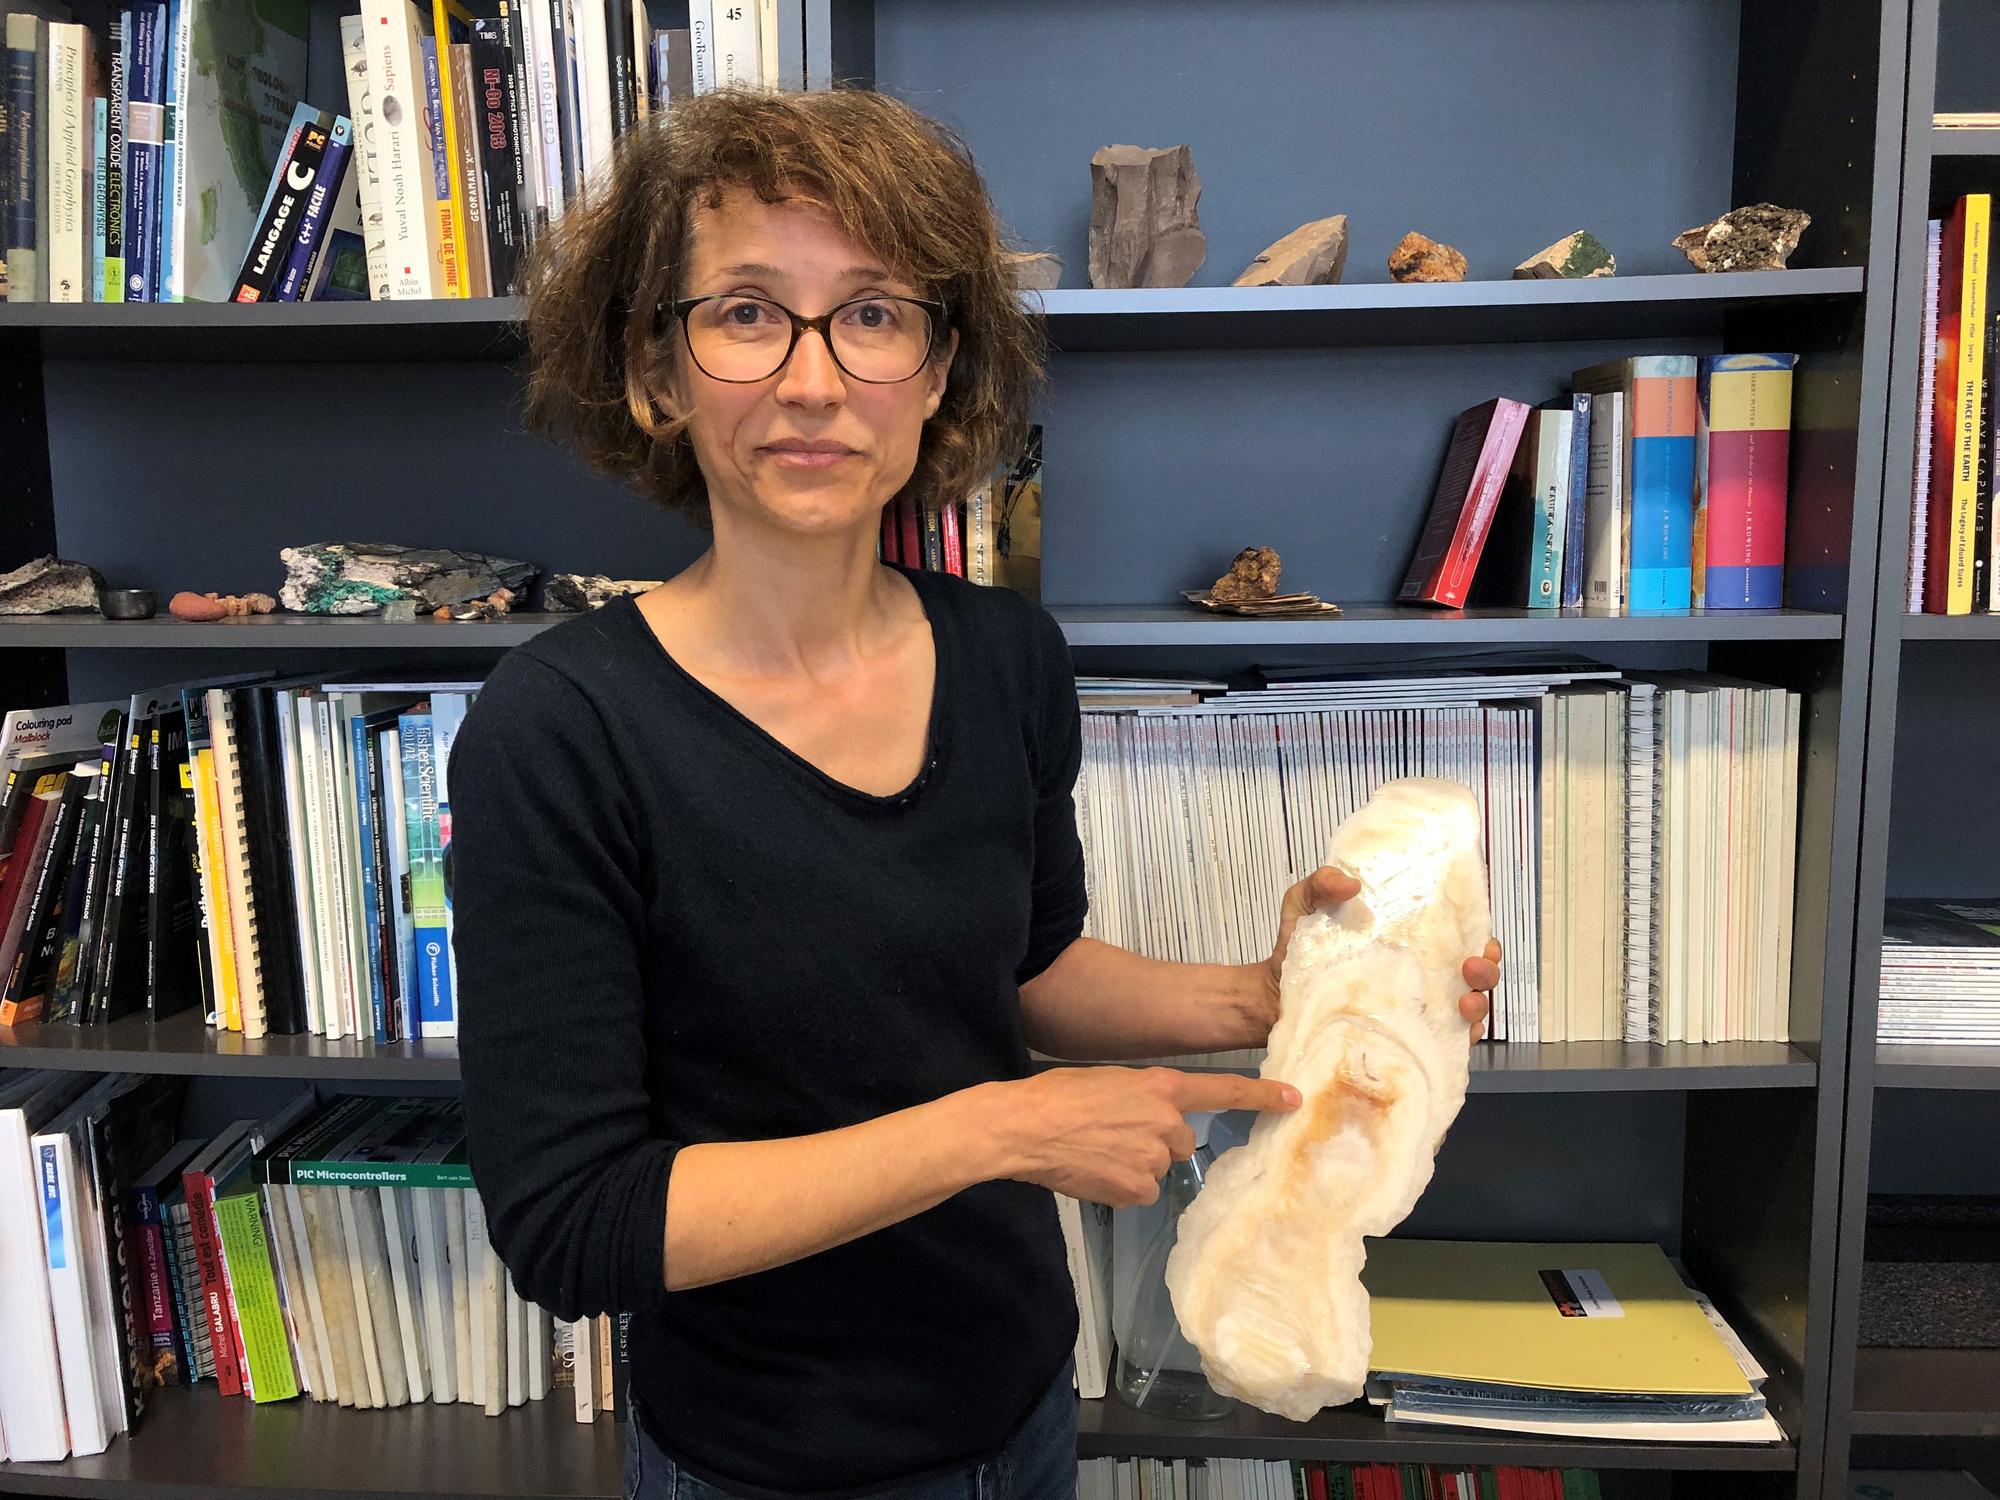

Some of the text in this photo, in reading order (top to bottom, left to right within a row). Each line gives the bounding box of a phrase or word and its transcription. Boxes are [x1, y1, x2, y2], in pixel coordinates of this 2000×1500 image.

[726, 7, 742, 21] 45
[478, 31, 497, 40] TMS
[383, 44, 396, 91] Sapiens
[517, 63, 525, 79] 2020
[507, 73, 515, 89] 2020
[518, 80, 526, 106] IMAGING
[508, 90, 516, 112] OPTICS
[540, 61, 555, 145] Catalogus
[63, 45, 78, 233] Principles of Applied Geophysics
[307, 129, 326, 145] PC
[488, 112, 507, 150] 2013
[511, 119, 520, 156] PHOTONICS
[109, 51, 122, 246] TRANSPARENT OXIDE ELECTRONICS
[515, 156, 523, 185] CATALOG
[96, 156, 106, 237] FIELD GEOPHYSICS
[390, 130, 409, 241] Yuval Noah Harari
[467, 168, 480, 222] GEORAMAN
[252, 194, 296, 276] LANGAGE
[286, 160, 316, 191] C
[298, 183, 327, 245] C++ FACILE
[440, 208, 458, 288] FRANK DE WINNE
[398, 285, 422, 296] Michel
[400, 277, 419, 286] Albin
[1961, 380, 1974, 482] THE FACE OF THE EARTH
[1960, 498, 1968, 511] The
[1543, 485, 1556, 573] JULES VERNE
[1957, 511, 1967, 535] Legacy
[1957, 543, 1966, 567] Eduard
[1957, 568, 1965, 588] Suess
[16, 714, 73, 731] Colouring pad
[13, 731, 51, 744] Malblock
[403, 725, 416, 759] 2011/12
[442, 730, 450, 749] Agar
[128, 749, 138, 775] Edmund
[150, 744, 159, 770] Edmund
[98, 776, 108, 802] Edmund
[91, 837, 99, 857] OPTICS
[119, 832, 128, 858] IMAGING
[25, 802, 67, 931] Building Wireless Sensor Networks Using Arduino
[85, 863, 95, 895] PHOTONICS
[117, 859, 125, 879] OPTICS
[114, 879, 122, 897] BOOK
[83, 895, 92, 920] CATALOG
[430, 956, 440, 1006] Fisher Scientific
[296, 1169, 407, 1182] PIC Microcontrollers
[244, 1196, 263, 1249] WARNING!
[190, 1192, 218, 1286] Tout est comédie
[146, 1228, 164, 1321] Tanzanie et Zanzibar
[209, 1291, 229, 1358] Michel GALABRU
